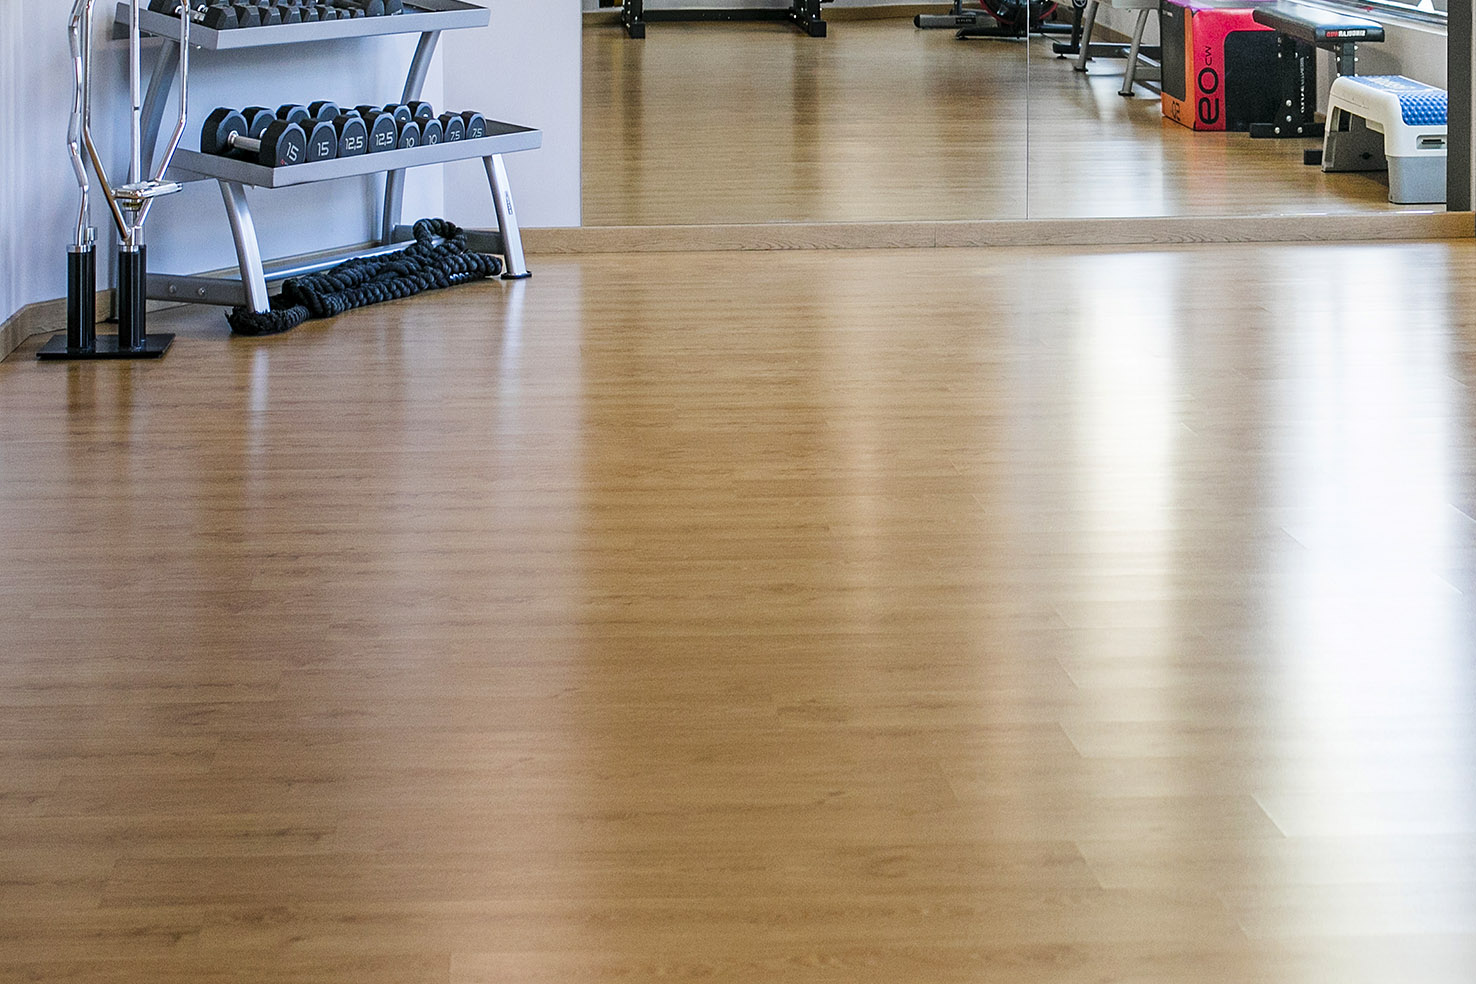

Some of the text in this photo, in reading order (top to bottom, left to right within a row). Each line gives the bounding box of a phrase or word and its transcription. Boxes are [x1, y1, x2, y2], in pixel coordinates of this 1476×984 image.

[405, 137, 415, 148] 10
[428, 134, 438, 145] 10
[286, 142, 299, 162] 15
[317, 141, 329, 156] 15
